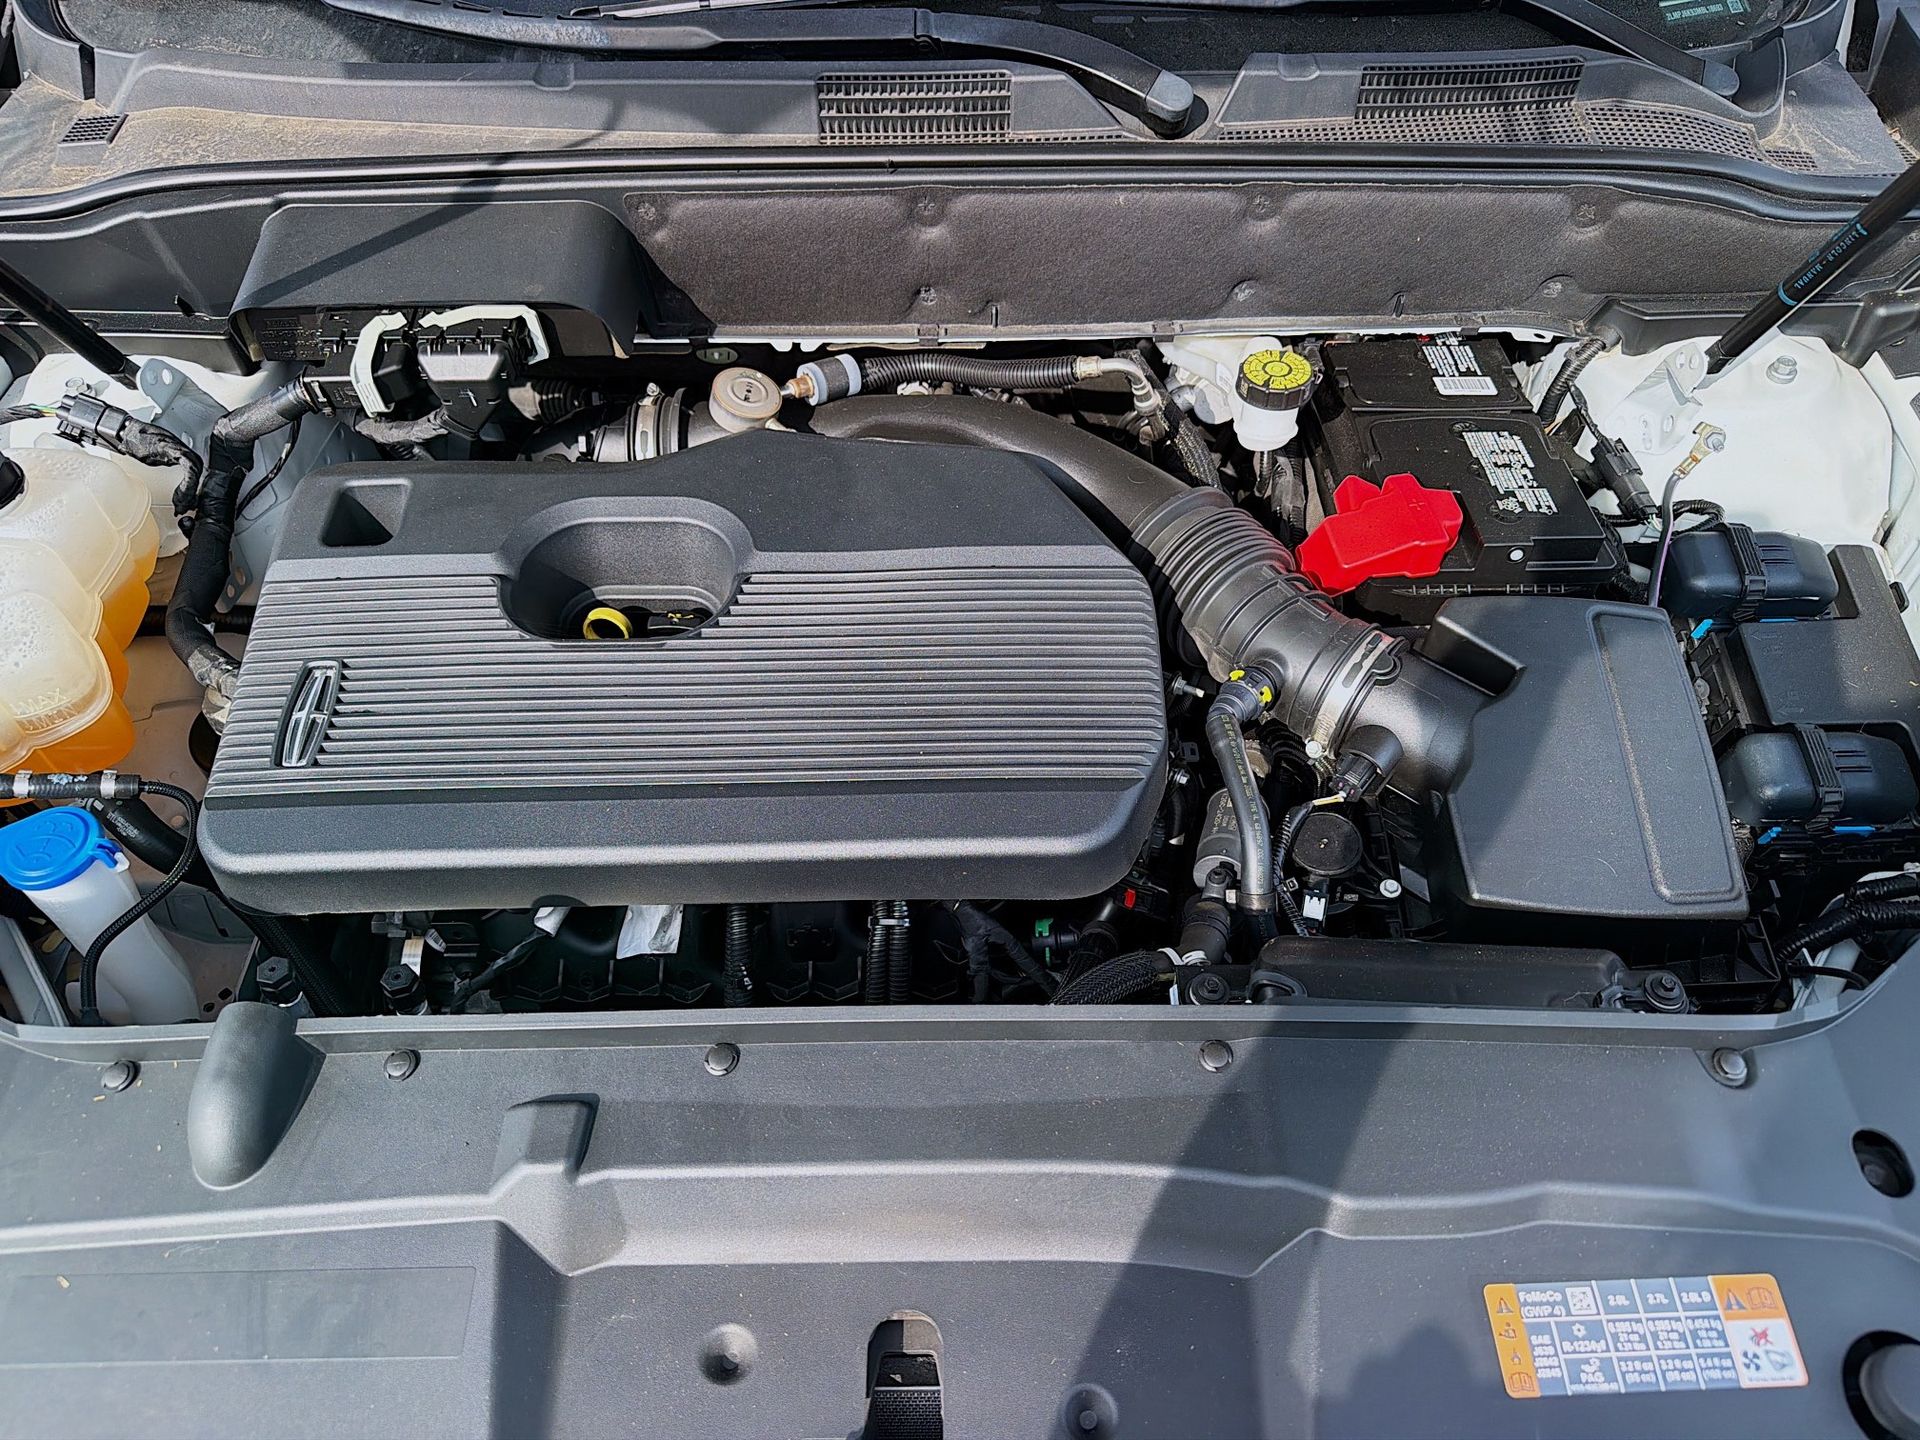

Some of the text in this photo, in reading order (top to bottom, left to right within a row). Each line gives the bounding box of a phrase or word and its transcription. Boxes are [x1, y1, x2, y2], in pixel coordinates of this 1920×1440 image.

[1826, 231, 1860, 262] LINCOLN
[1793, 263, 1823, 289] MANUAL
[20, 687, 68, 714] MAX
[35, 703, 79, 729] MIN
[1518, 1290, 1562, 1303] FoMoCo
[1521, 1306, 1552, 1319] (GWP
[1530, 1335, 1551, 1345] SAE
[1562, 1340, 1606, 1353] R-1234yf
[1580, 1371, 1605, 1383] PAG
